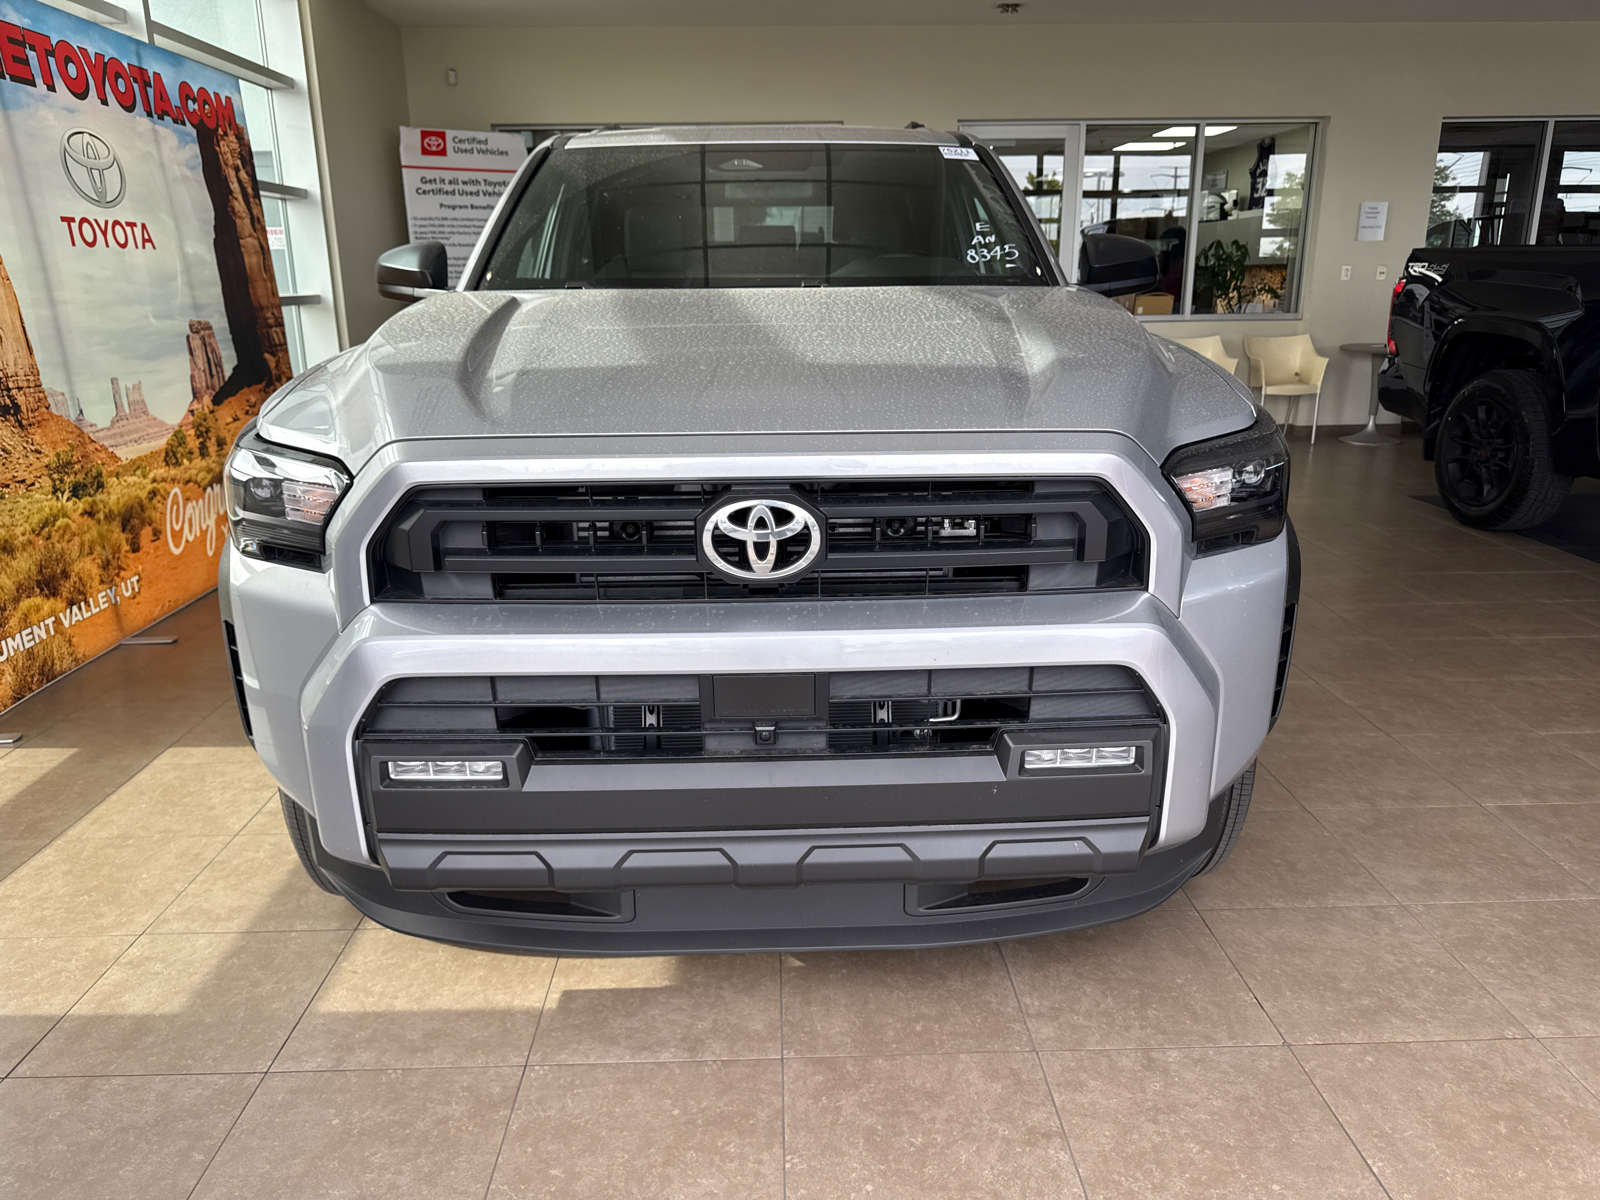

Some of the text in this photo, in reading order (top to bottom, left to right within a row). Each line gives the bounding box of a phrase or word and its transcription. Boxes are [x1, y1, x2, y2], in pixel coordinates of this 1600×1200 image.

[0, 20, 238, 136] ETOYOTA.COM
[452, 136, 488, 146] Certified
[453, 147, 509, 157] Used Vehicles
[420, 176, 437, 186] Get
[439, 177, 447, 186] it
[448, 177, 460, 186] all
[461, 178, 481, 187] with
[416, 187, 456, 197] Certified
[458, 188, 480, 197] Used
[440, 203, 469, 211] Program
[975, 222, 990, 231] E
[60, 215, 157, 250] TOYOTA
[966, 244, 1020, 264] 8345
[166, 483, 226, 557] Congr
[59, 585, 121, 629] VALLEY,
[121, 575, 140, 598] UT
